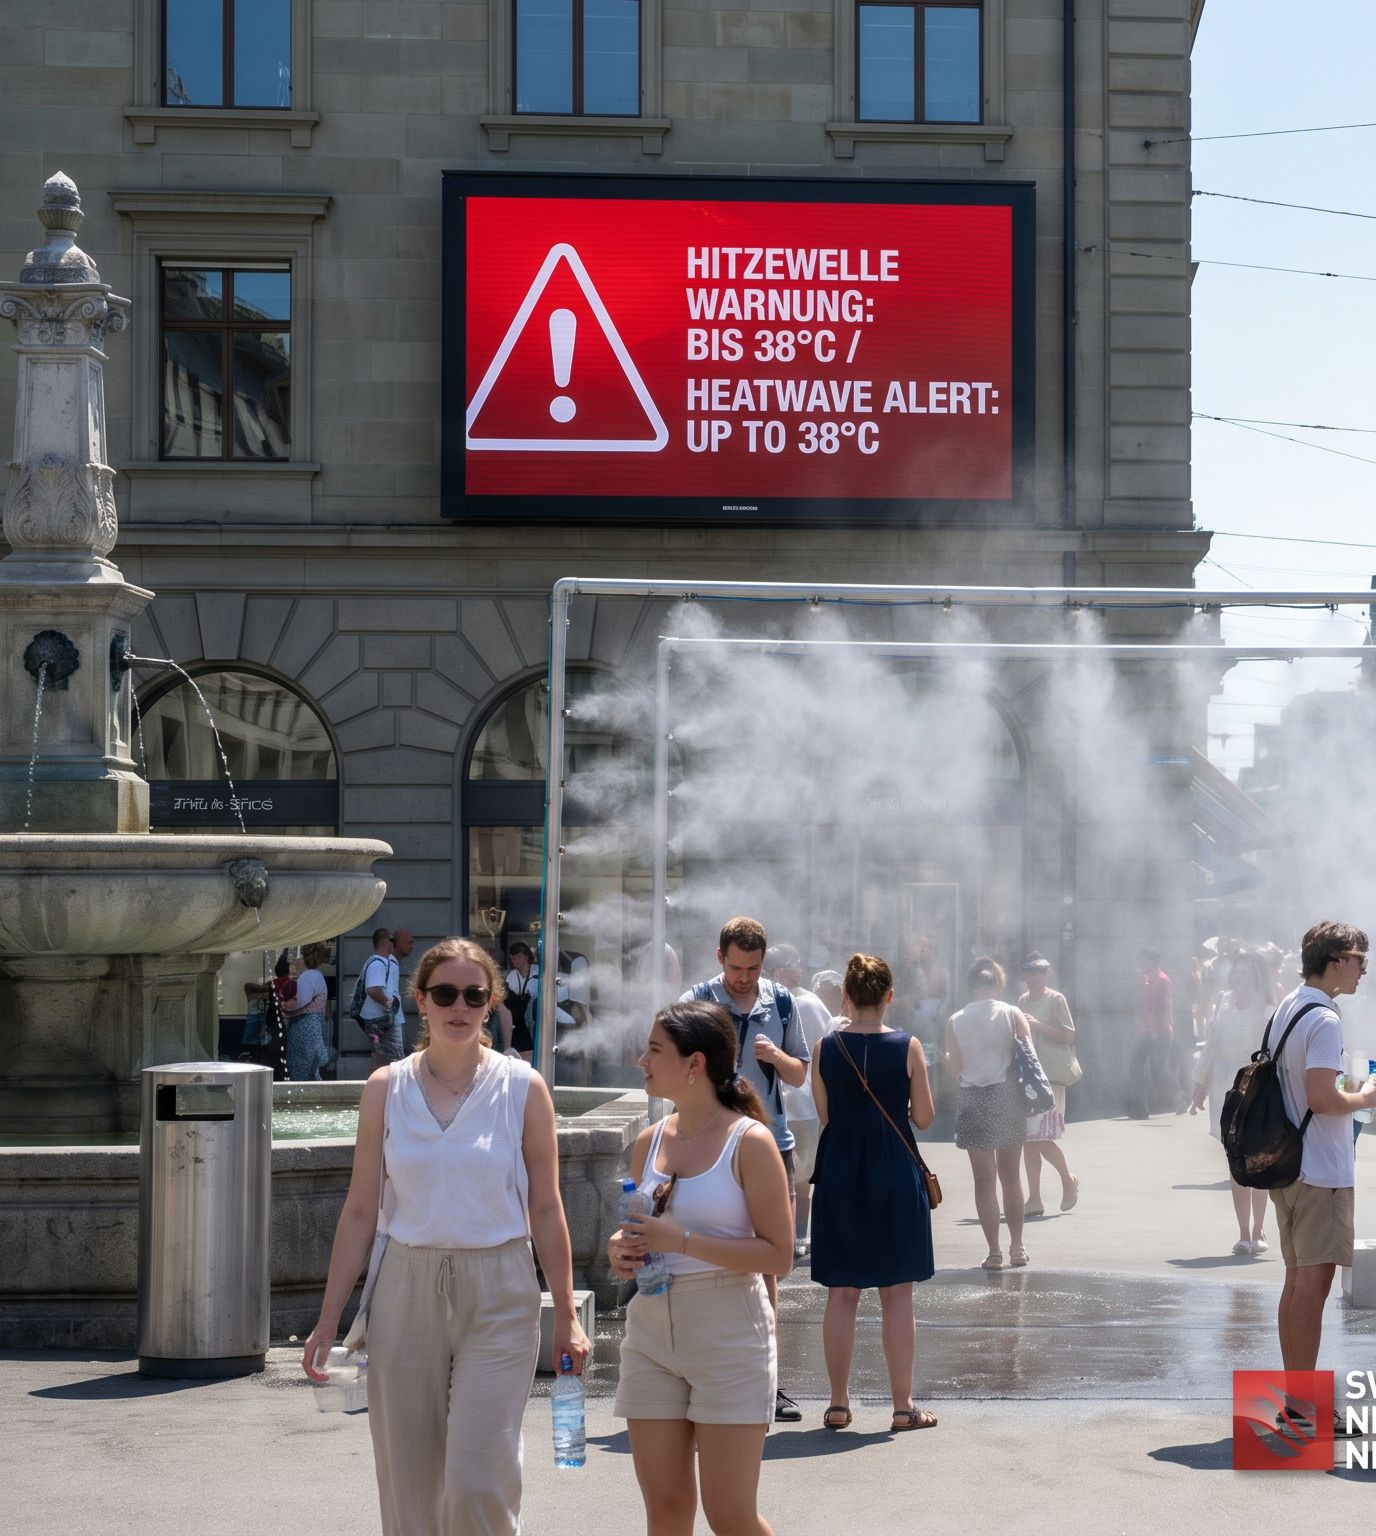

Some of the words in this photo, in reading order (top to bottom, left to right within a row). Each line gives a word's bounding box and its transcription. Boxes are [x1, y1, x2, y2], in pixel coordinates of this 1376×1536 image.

[687, 246, 900, 282] HITZEWELLE
[686, 288, 874, 322] WARNUNG:
[687, 328, 744, 362] BIS
[754, 329, 836, 363] 38°C
[846, 329, 862, 364] /
[687, 378, 873, 414] HEATWAVE
[882, 381, 999, 415] ALERT:
[687, 420, 732, 453] UP
[742, 420, 786, 454] TO
[798, 421, 880, 455] 38°C
